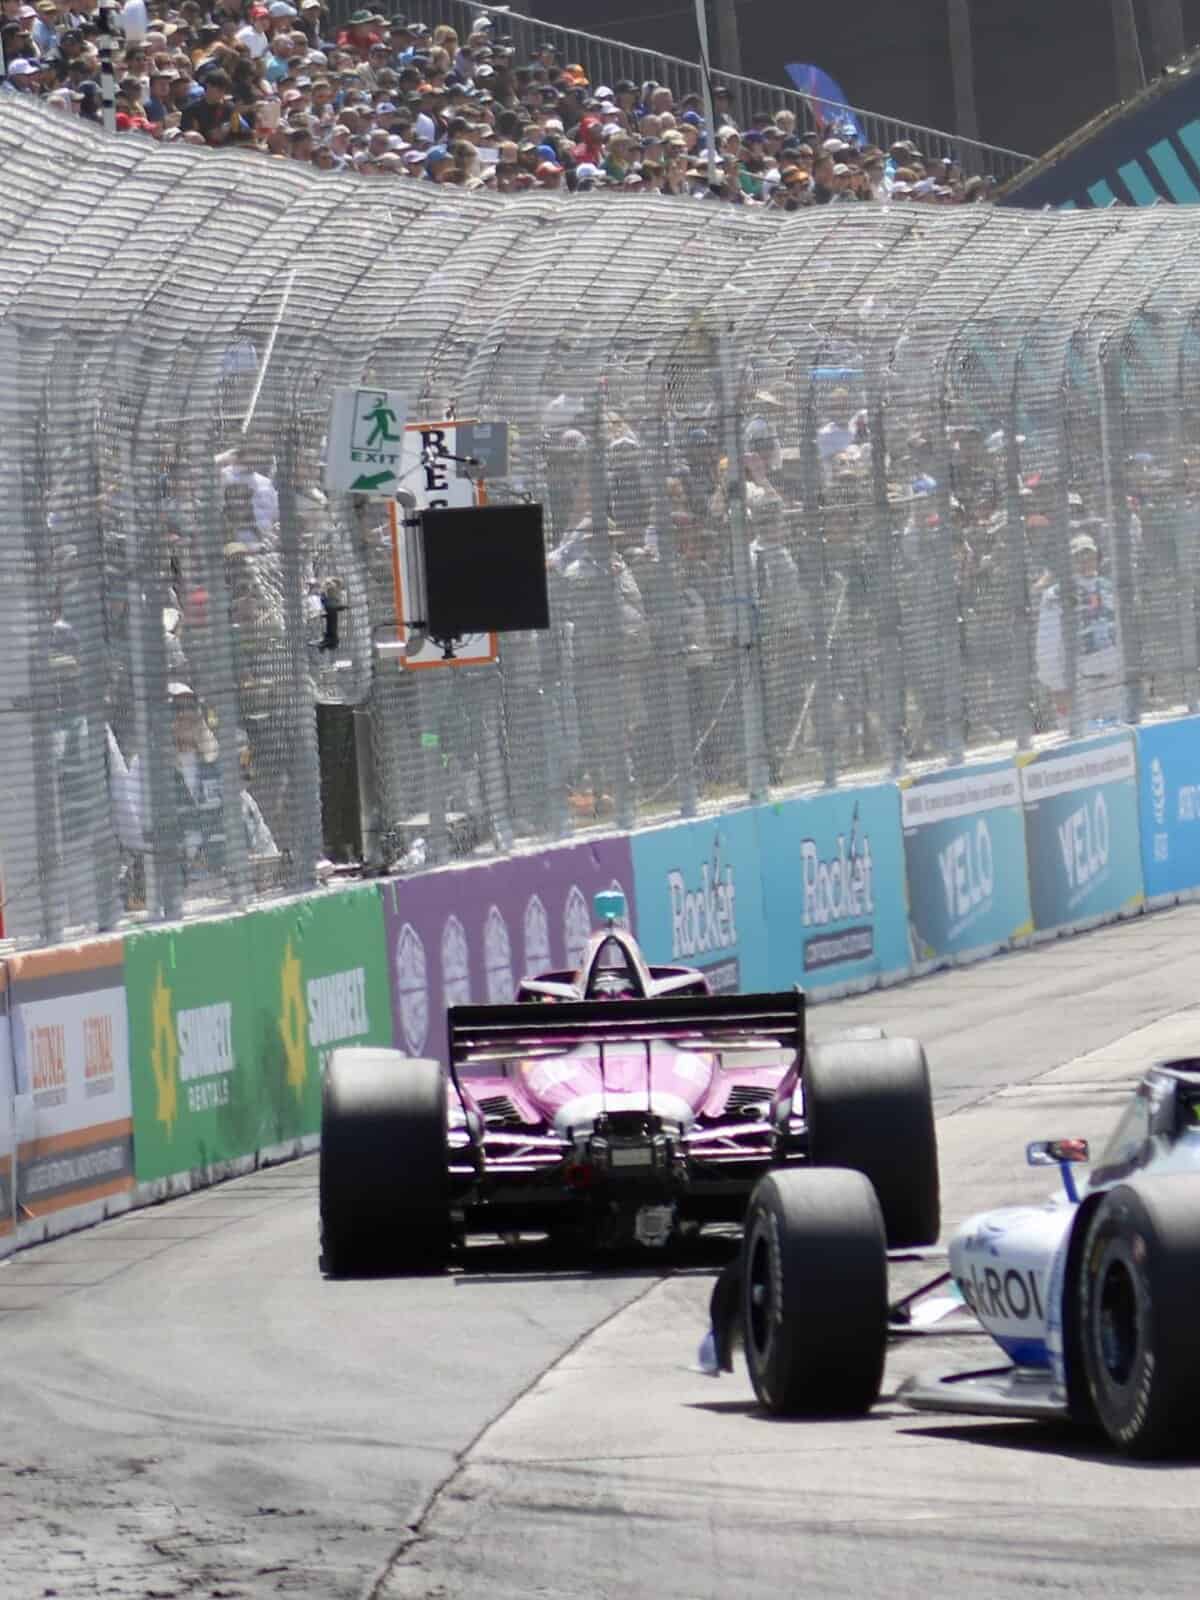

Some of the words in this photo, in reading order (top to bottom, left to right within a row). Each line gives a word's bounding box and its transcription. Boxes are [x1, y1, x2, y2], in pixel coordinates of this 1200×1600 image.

[351, 451, 399, 464] EXIT
[801, 833, 874, 928] Rocket
[939, 817, 993, 921] VELO
[1059, 790, 1109, 888] VELO
[667, 862, 738, 961] Rocket
[188, 1077, 230, 1113] RENTALS
